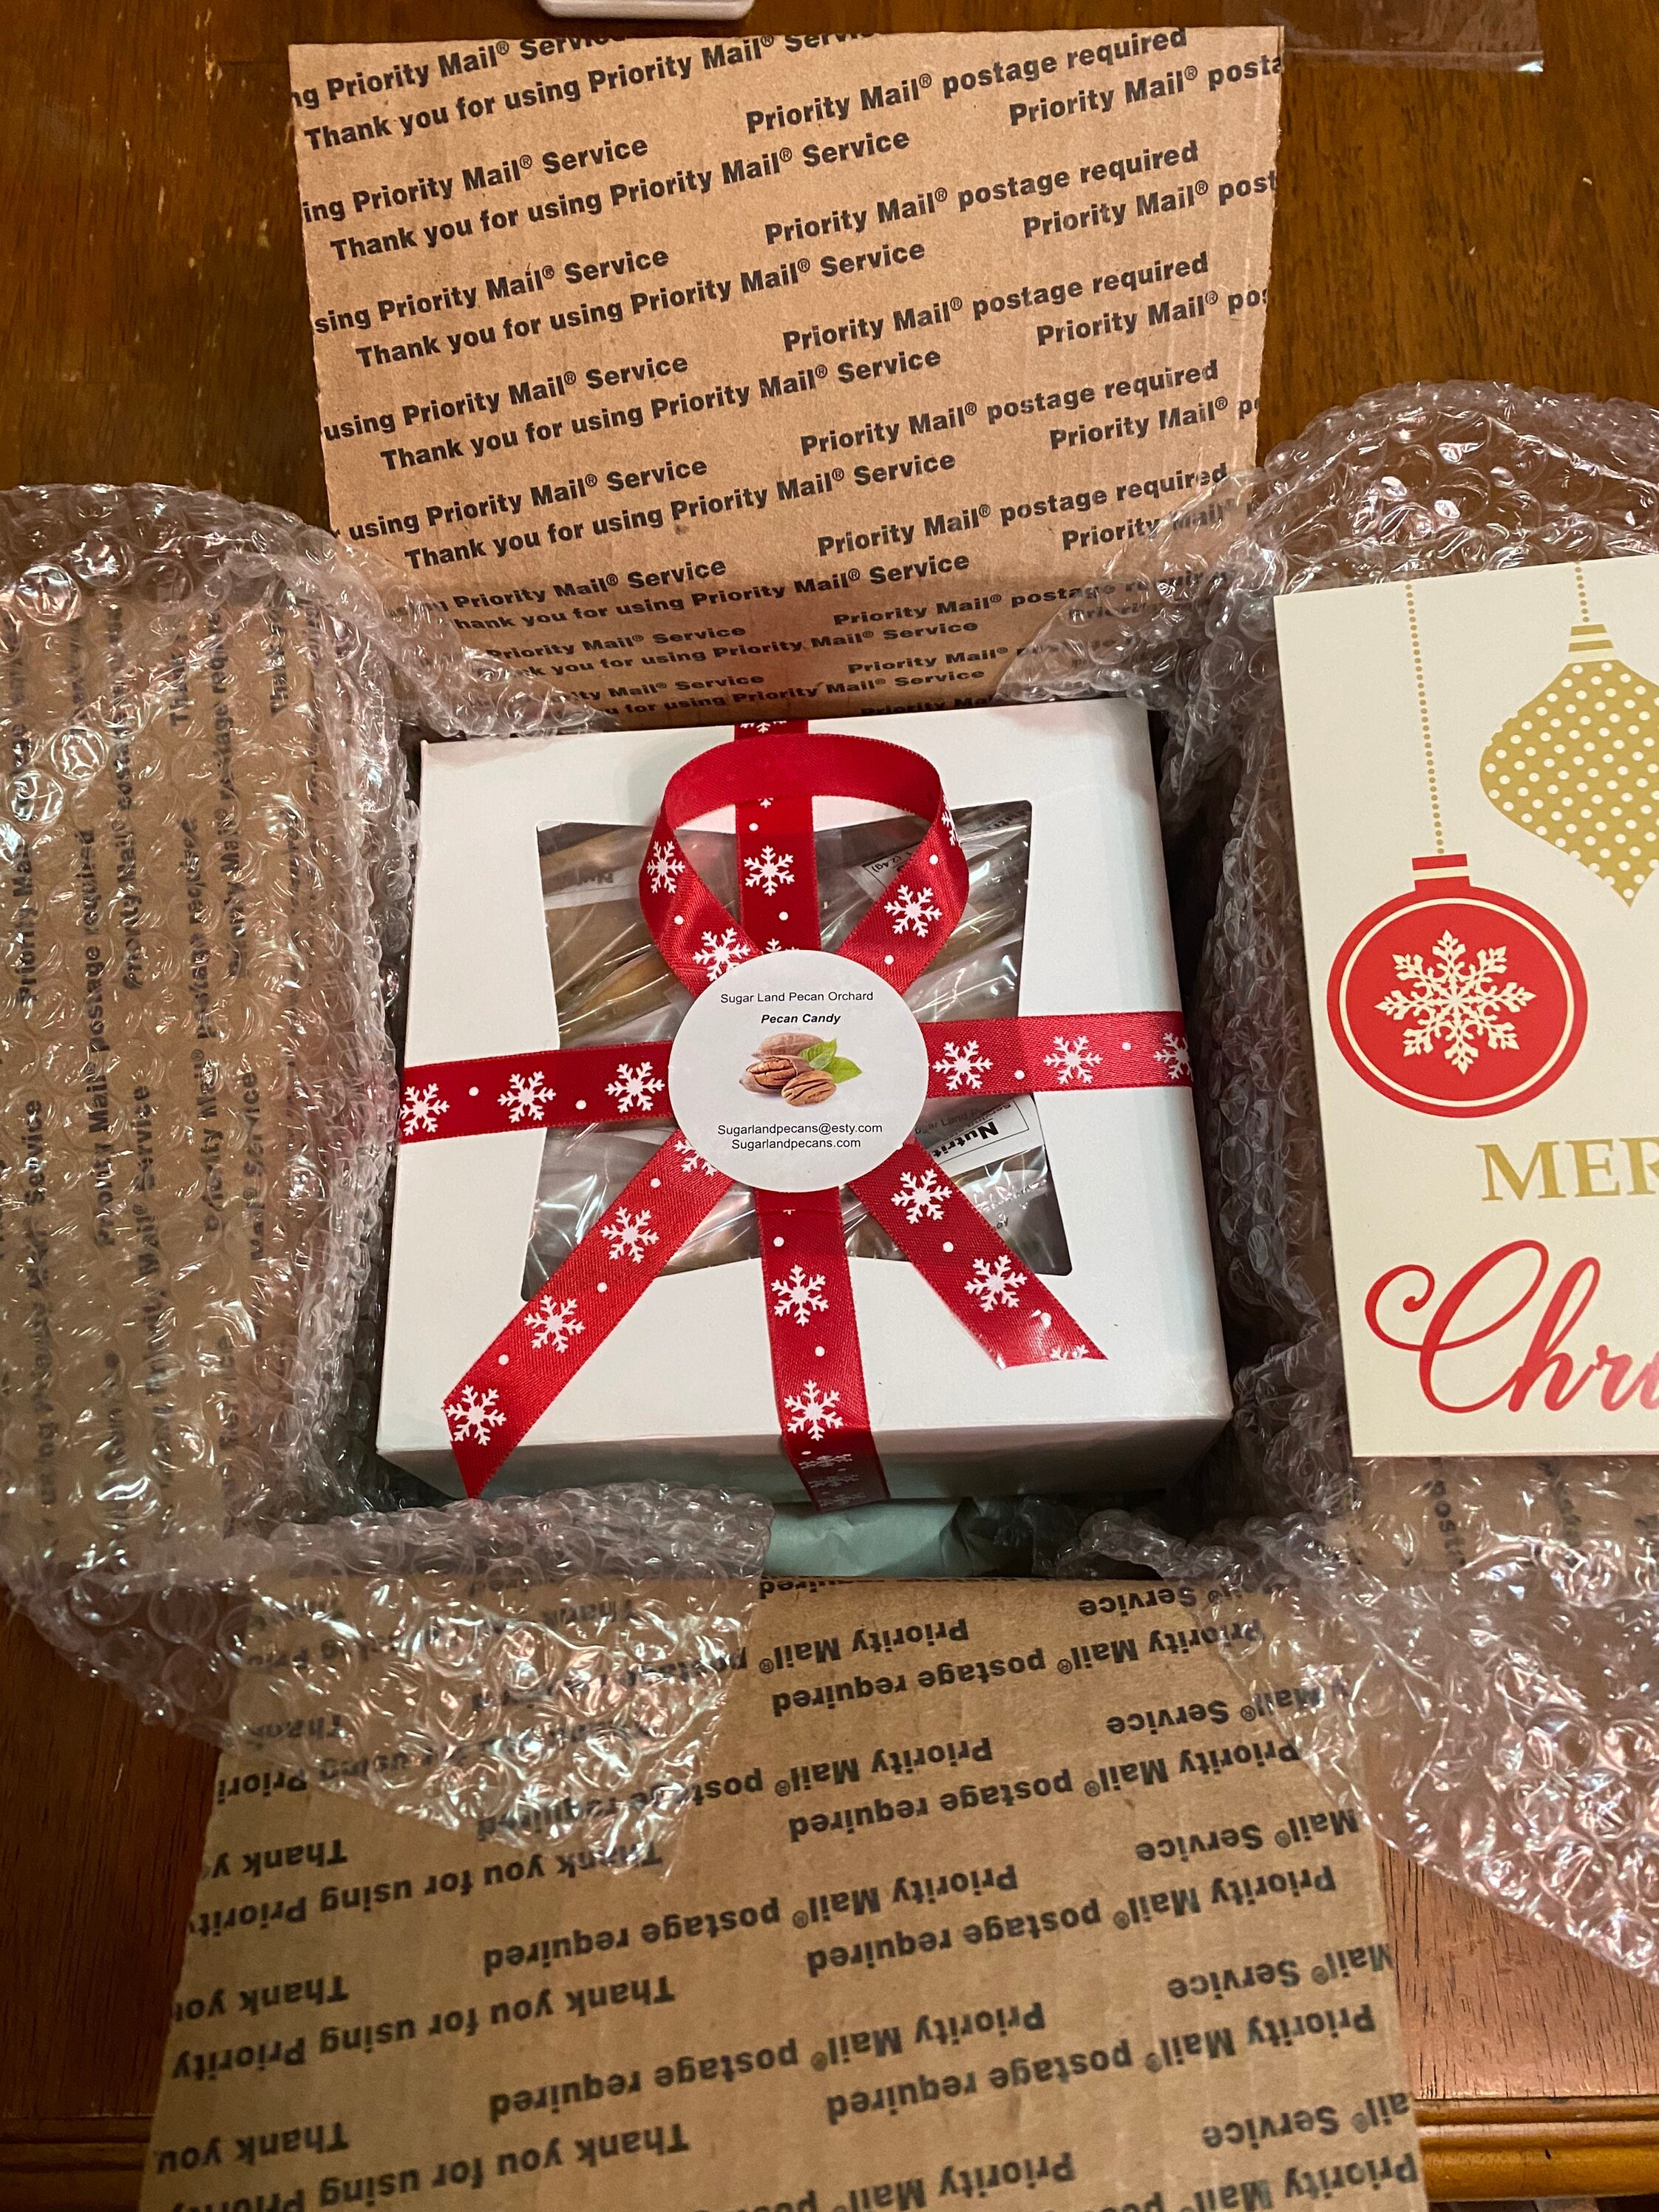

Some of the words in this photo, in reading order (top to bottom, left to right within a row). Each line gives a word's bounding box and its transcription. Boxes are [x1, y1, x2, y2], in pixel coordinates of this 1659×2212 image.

[327, 64, 428, 100] Priority
[747, 97, 849, 134] Priority
[943, 57, 1056, 99] postage
[1068, 33, 1186, 69] required
[305, 116, 391, 149] Thank
[399, 107, 448, 136] you
[456, 97, 495, 120] for
[504, 81, 580, 109] using
[588, 56, 691, 92] Priority
[1010, 90, 1113, 126] Priority
[353, 178, 452, 212] Priority
[543, 140, 647, 174] Service
[765, 210, 866, 245] Priority
[959, 172, 1069, 212] postage
[1081, 140, 1198, 183] required
[330, 228, 417, 260] Thank
[424, 220, 472, 248] you
[480, 210, 518, 231] for
[528, 194, 601, 222] using
[610, 171, 711, 206] Priority
[803, 133, 909, 166] Service
[1023, 204, 1125, 238] Priority
[378, 287, 476, 321] Priority
[565, 251, 668, 283] Service
[325, 414, 395, 441] using
[402, 393, 499, 425] Priority
[586, 358, 687, 389] Service
[801, 423, 899, 455] Priority
[988, 388, 1094, 424] postage
[1105, 359, 1218, 398] required
[1051, 417, 1149, 449] Priority
[349, 515, 419, 540] using
[426, 495, 521, 526] Priority
[607, 461, 707, 491] Service
[404, 539, 486, 569] Thank
[493, 532, 540, 557] you
[548, 523, 583, 543] for
[593, 509, 662, 535] using
[671, 489, 767, 520] Priority
[855, 455, 954, 485] Service
[818, 525, 914, 556] Priority
[1000, 490, 1107, 526] postage
[1117, 463, 1227, 501] required
[453, 589, 545, 608] Priority
[628, 561, 725, 588] Service
[522, 613, 566, 626] you
[573, 608, 607, 618] for
[617, 599, 684, 614] using
[691, 586, 784, 605] Priority
[870, 556, 968, 584] Service
[653, 628, 745, 643] Service
[834, 608, 926, 625] Priority
[849, 658, 936, 673] Priority
[625, 703, 656, 715] for
[662, 696, 727, 711] using
[733, 688, 818, 704] Priority
[895, 671, 985, 688] Service
[720, 993, 754, 1005] Sugar
[757, 992, 785, 1002] Land
[789, 991, 824, 1002] Pecan
[828, 991, 874, 1001] Orchard
[761, 1014, 798, 1024] Pecan
[802, 1013, 841, 1025] Candy
[717, 1122, 883, 1137] Sugarlandpecans@esty.com
[731, 1139, 861, 1150] Sugarlandpecans.com
[852, 1619, 968, 1652] Priority
[918, 1648, 1045, 1687] postage
[773, 1675, 906, 1717] required
[1107, 1700, 1229, 1734] Service
[872, 1738, 992, 1774] Priority
[1180, 1741, 1300, 1774] Priority
[940, 1769, 1073, 1811] postage
[789, 1798, 928, 1842] required
[243, 1839, 347, 1876] Thank
[1136, 1825, 1263, 1862] Service
[425, 1870, 472, 1896] for
[484, 1854, 544, 1884] you
[894, 1865, 1017, 1904] Priority
[1212, 1866, 1336, 1905] Priority
[321, 1880, 411, 1912] using
[642, 1898, 779, 1943] postage
[964, 1899, 1100, 1944] postage
[484, 1928, 628, 1976] required
[807, 1930, 951, 1978] required
[491, 1989, 552, 2024] you
[566, 1976, 674, 2016] Thank
[321, 2019, 415, 2053] using
[429, 2009, 478, 2036] for
[1249, 2004, 1375, 2046] Priority
[174, 2038, 305, 2080] Priority
[990, 2040, 1131, 2089] postage
[827, 2073, 976, 2125] required
[159, 2137, 221, 2172] you
[236, 2123, 348, 2165] Thank
[498, 2138, 562, 2175] you
[575, 2124, 689, 2167] Thank
[320, 2170, 419, 2207] using
[433, 2159, 483, 2189] for
